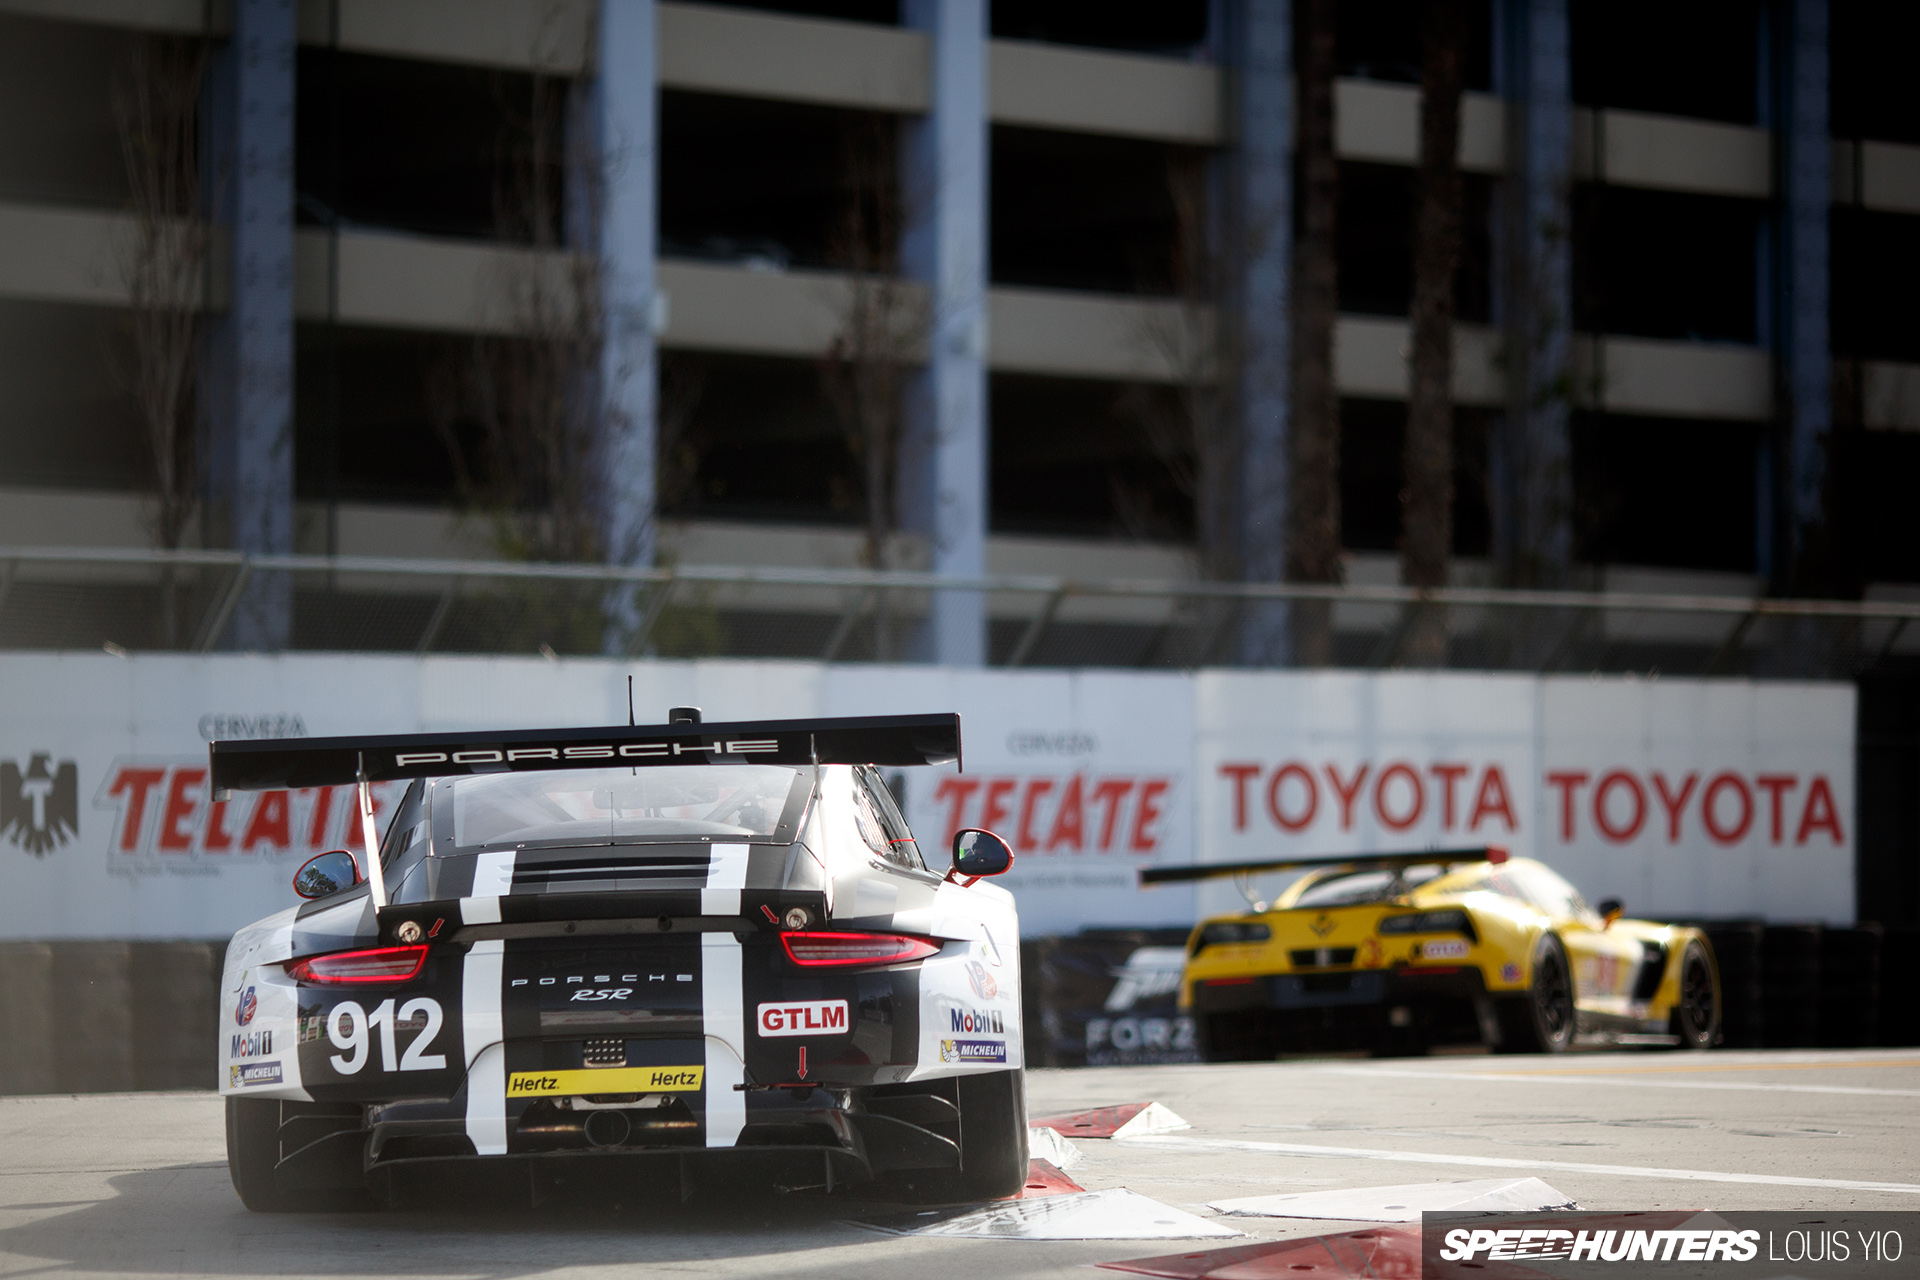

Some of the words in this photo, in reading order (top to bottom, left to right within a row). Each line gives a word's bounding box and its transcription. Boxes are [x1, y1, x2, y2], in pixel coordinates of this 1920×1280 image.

[198, 711, 308, 740] CERVEZA
[396, 740, 779, 767] PORSCHE
[1218, 761, 1519, 834] TOYOTA
[1545, 767, 1846, 847] TOYOTA
[933, 770, 1170, 854] TECATE
[512, 974, 694, 987] PORSCHE
[570, 988, 633, 1001] RSR
[762, 1006, 845, 1031] GTLM
[951, 1008, 990, 1033] Mobil
[231, 1032, 261, 1059] Mobil
[327, 997, 447, 1075] 912
[1086, 1017, 1196, 1049] FORZ
[960, 1045, 1005, 1056] MICHELIN
[244, 1066, 281, 1078] MICHELIN
[512, 1076, 559, 1091] Hertz
[650, 1071, 698, 1086] Hertz
